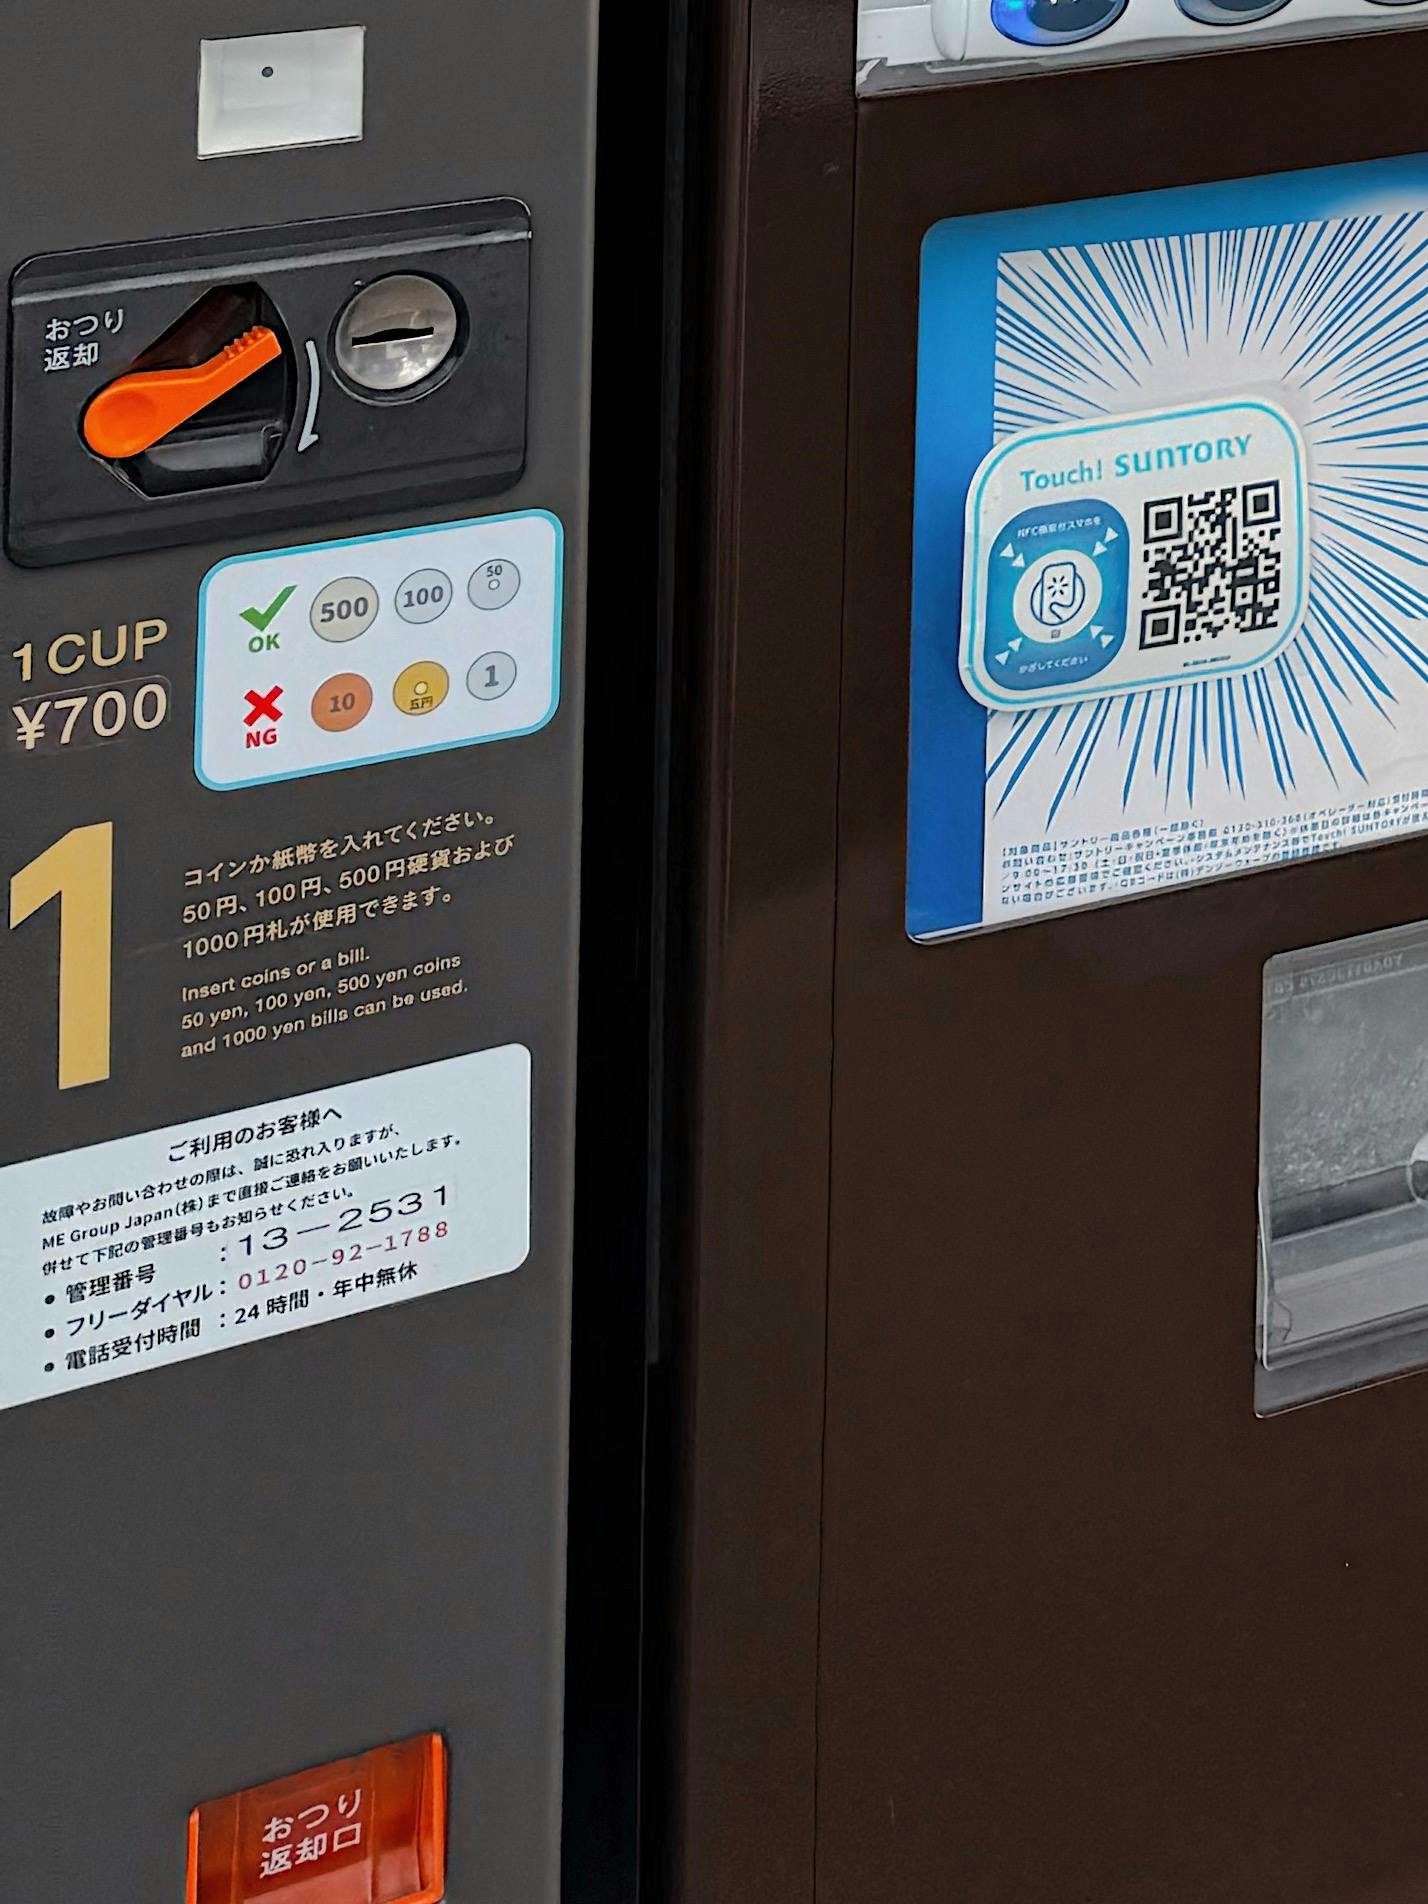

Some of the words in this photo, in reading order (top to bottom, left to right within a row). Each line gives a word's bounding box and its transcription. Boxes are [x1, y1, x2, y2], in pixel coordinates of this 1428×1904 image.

[45, 308, 125, 342] おつり
[43, 346, 100, 373] 返却
[1020, 460, 1102, 492] Touch!
[1114, 434, 1252, 477] SUNTORY
[403, 584, 444, 609] 100
[486, 563, 503, 577] 50
[320, 595, 369, 623] 500
[248, 632, 281, 654] OK
[328, 693, 357, 713] 10
[484, 664, 499, 689] 1
[13, 682, 168, 750] ¥700
[245, 728, 278, 750] NG
[183, 810, 496, 889] コインか紙幣を入れてください。
[182, 889, 454, 959] 1000円札が使用できます。
[9, 819, 114, 1091] 1
[182, 977, 236, 1002] Insert
[241, 962, 290, 988] coins
[296, 960, 317, 977] or
[321, 957, 332, 971] a
[337, 947, 371, 969] bill.
[180, 1036, 217, 1058] and
[222, 1024, 268, 1050] 1000
[272, 1017, 306, 1043] yen
[311, 1005, 349, 1029] bills
[354, 998, 387, 1019] can
[392, 990, 415, 1010] be
[420, 980, 469, 1005] used.
[182, 1008, 205, 1031] 50
[209, 1002, 249, 1028] yen,
[255, 991, 288, 1012] 100
[293, 983, 332, 1010] yen,
[337, 972, 370, 994] 500
[374, 965, 408, 989] yen
[413, 952, 462, 979] coins
[167, 1105, 343, 1164] ご利用のお客様へ
[42, 1229, 65, 1251] ME
[69, 1213, 121, 1245] Group
[65, 1261, 158, 1305] 管理番号
[65, 1317, 202, 1372] 電話受付時間
[262, 1788, 362, 1844] おつり
[259, 1822, 362, 1880] 返却口
